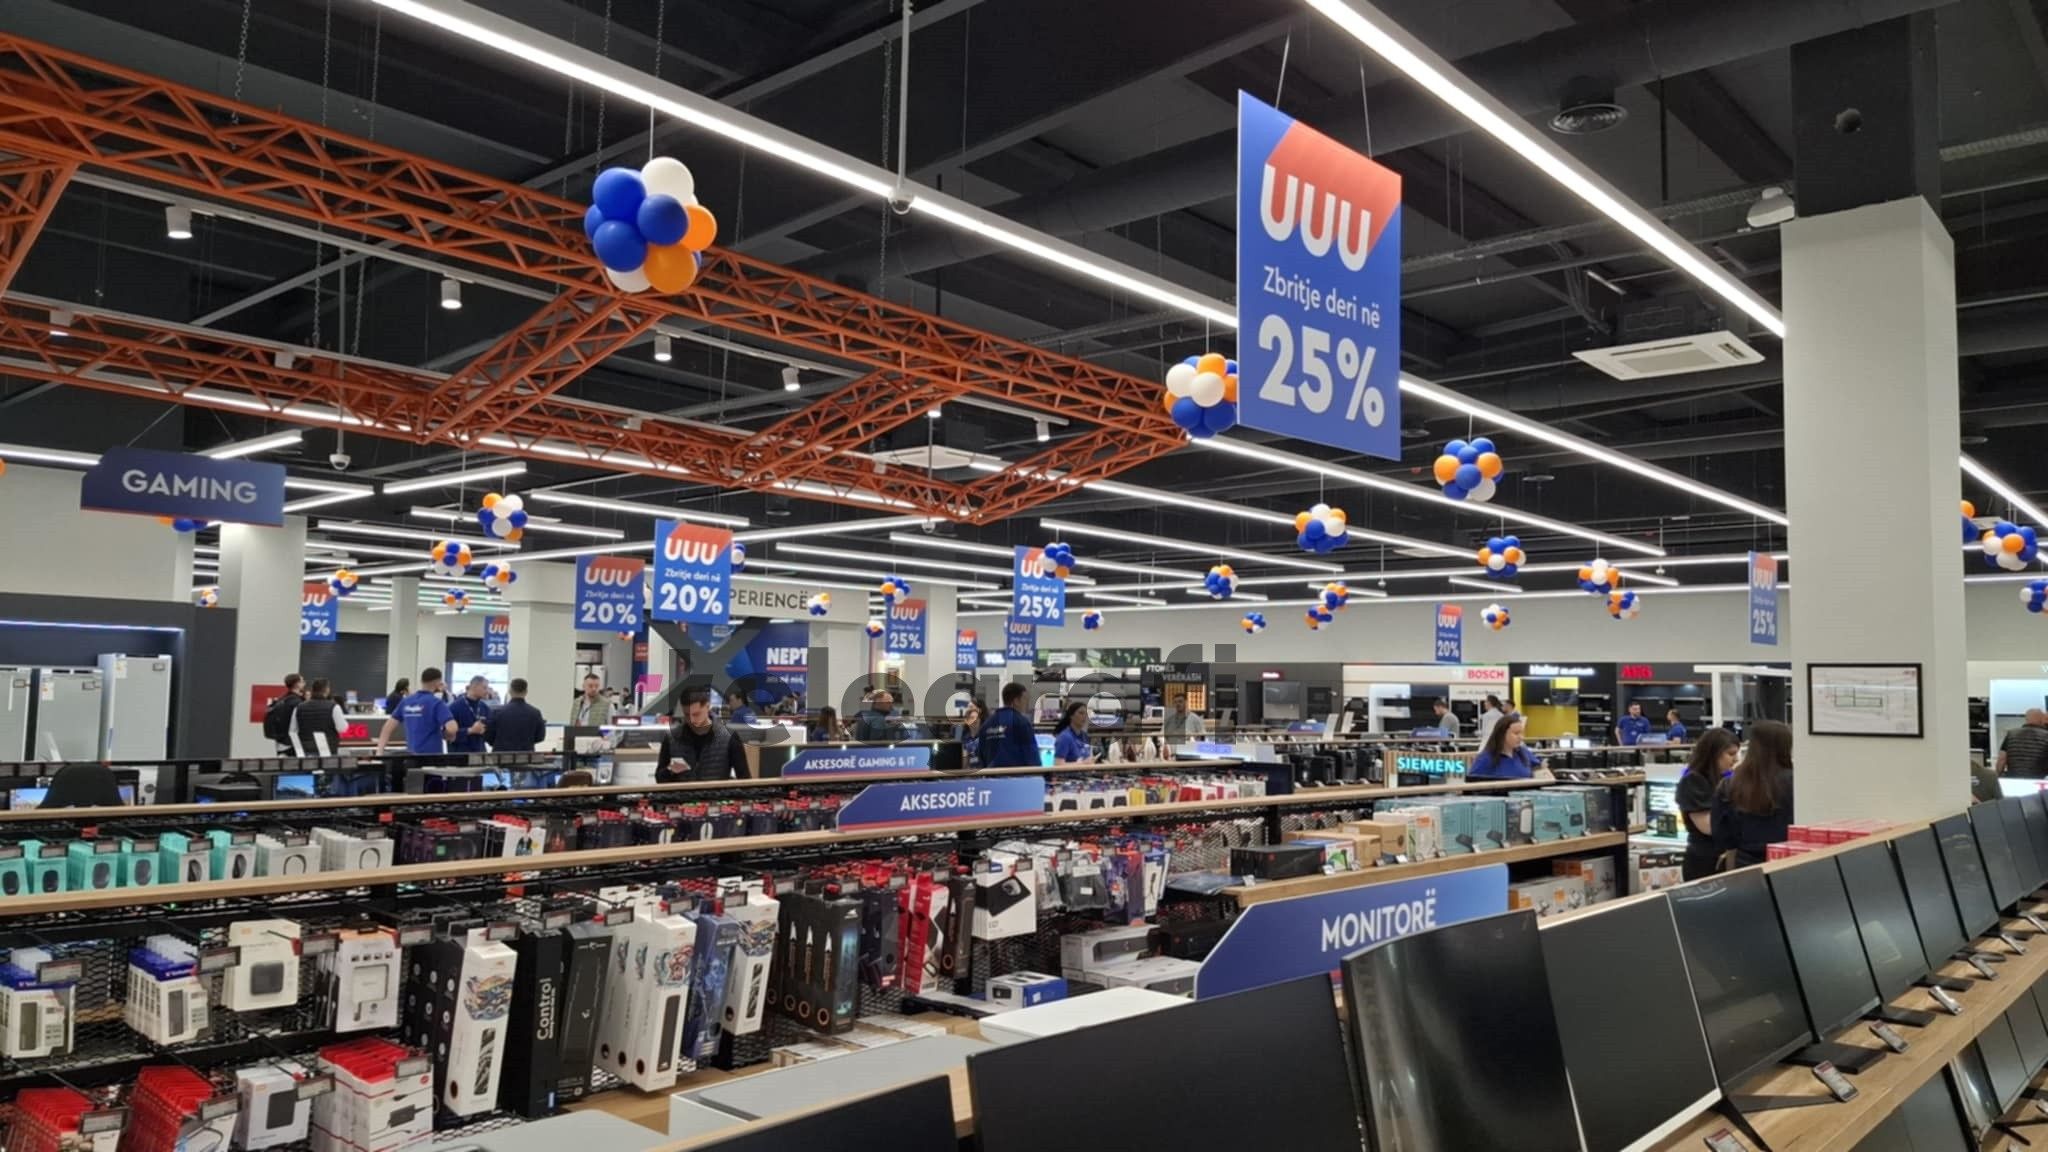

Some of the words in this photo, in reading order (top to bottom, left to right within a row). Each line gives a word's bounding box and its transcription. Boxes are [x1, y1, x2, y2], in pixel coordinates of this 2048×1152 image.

[1260, 163, 1372, 271] UUU
[1263, 265, 1321, 311] Zbritje
[1325, 287, 1357, 321] deri
[1361, 302, 1381, 328] në
[1257, 314, 1385, 428] 25%
[121, 469, 257, 504] GAMING
[664, 536, 718, 566] UUU
[584, 566, 632, 587] UUU
[664, 568, 693, 581] Zbritje
[694, 569, 710, 582] deri
[711, 572, 721, 583] në
[659, 582, 723, 615] 20%
[1019, 594, 1060, 619] 25%
[581, 601, 637, 625] 20%
[487, 643, 510, 656] 25
[889, 631, 922, 649] 25%
[1008, 643, 1034, 657] 20%
[1437, 640, 1460, 658] 20%
[1467, 669, 1505, 680] BOSCH
[804, 755, 857, 770] AKSESORË
[859, 756, 897, 769] GAMING
[906, 756, 917, 767] IT
[1397, 757, 1466, 774] SIEMENS
[900, 786, 976, 812] AKSESORË
[978, 790, 993, 806] IT
[1321, 887, 1438, 953] MONITORË
[536, 977, 552, 1041] Control
